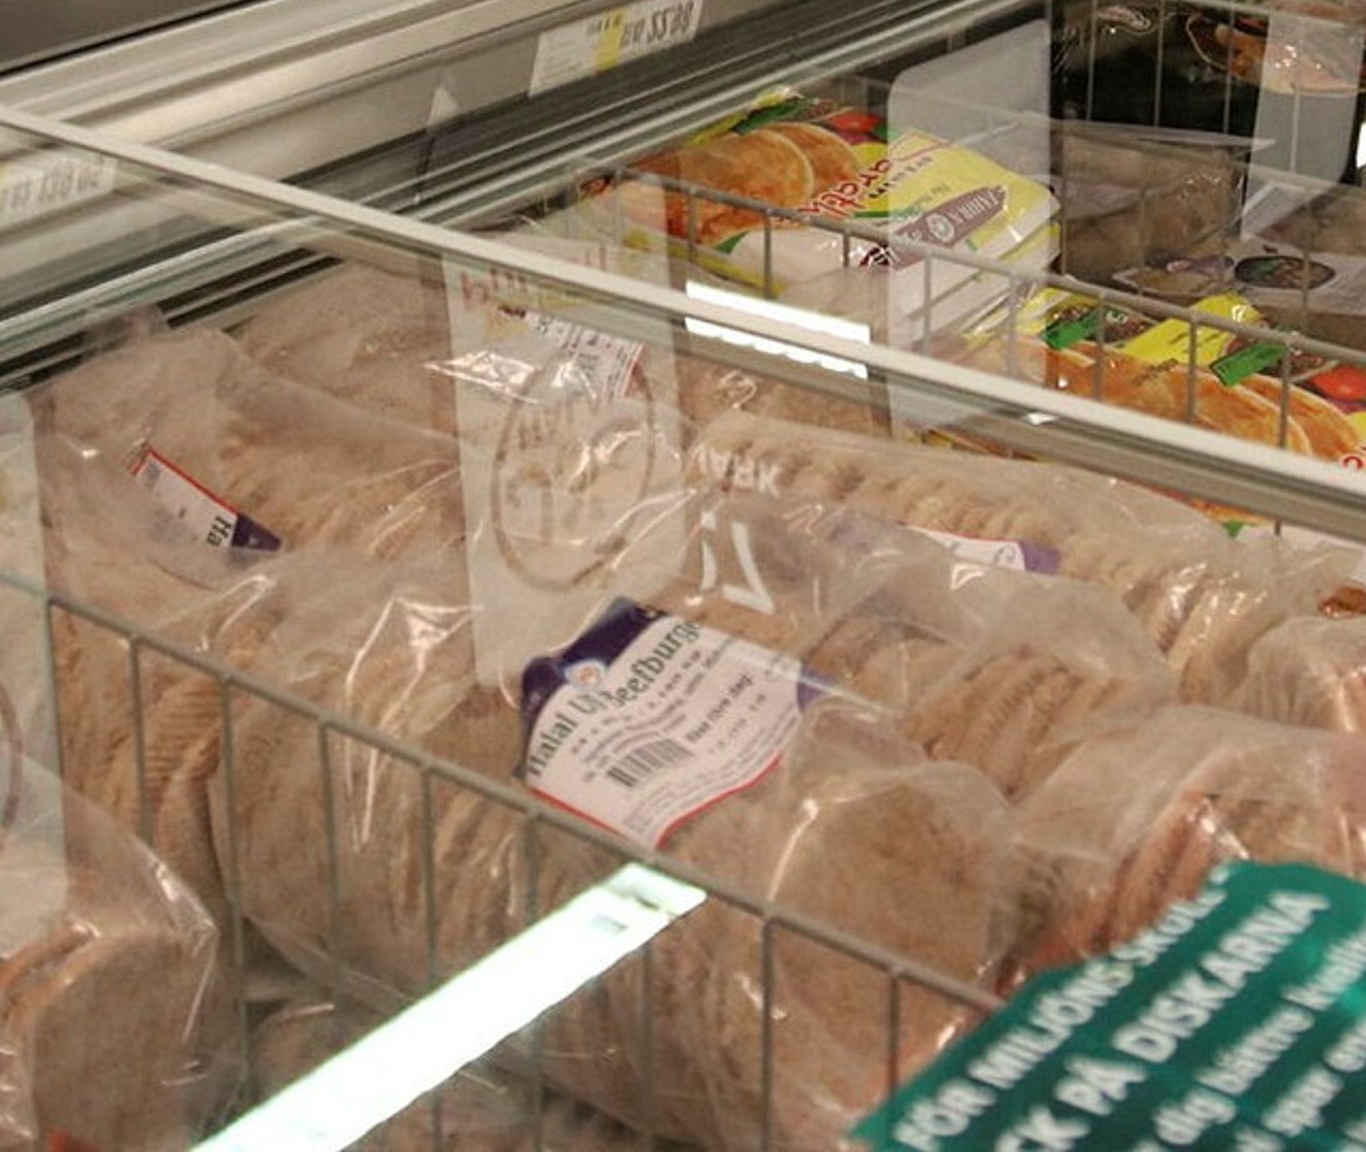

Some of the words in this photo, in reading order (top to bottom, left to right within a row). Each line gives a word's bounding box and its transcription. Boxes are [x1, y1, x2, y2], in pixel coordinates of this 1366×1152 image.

[526, 711, 580, 777] Halal
[892, 1075, 998, 1151] FÖR
[968, 959, 1136, 1091] MILJÖNS
[1055, 1055, 1148, 1117] PÅ
[1112, 889, 1331, 1066] DISKARNA
[1152, 1087, 1237, 1147] dig
[1197, 1005, 1316, 1098] bättre
[1261, 1065, 1343, 1139] spar
